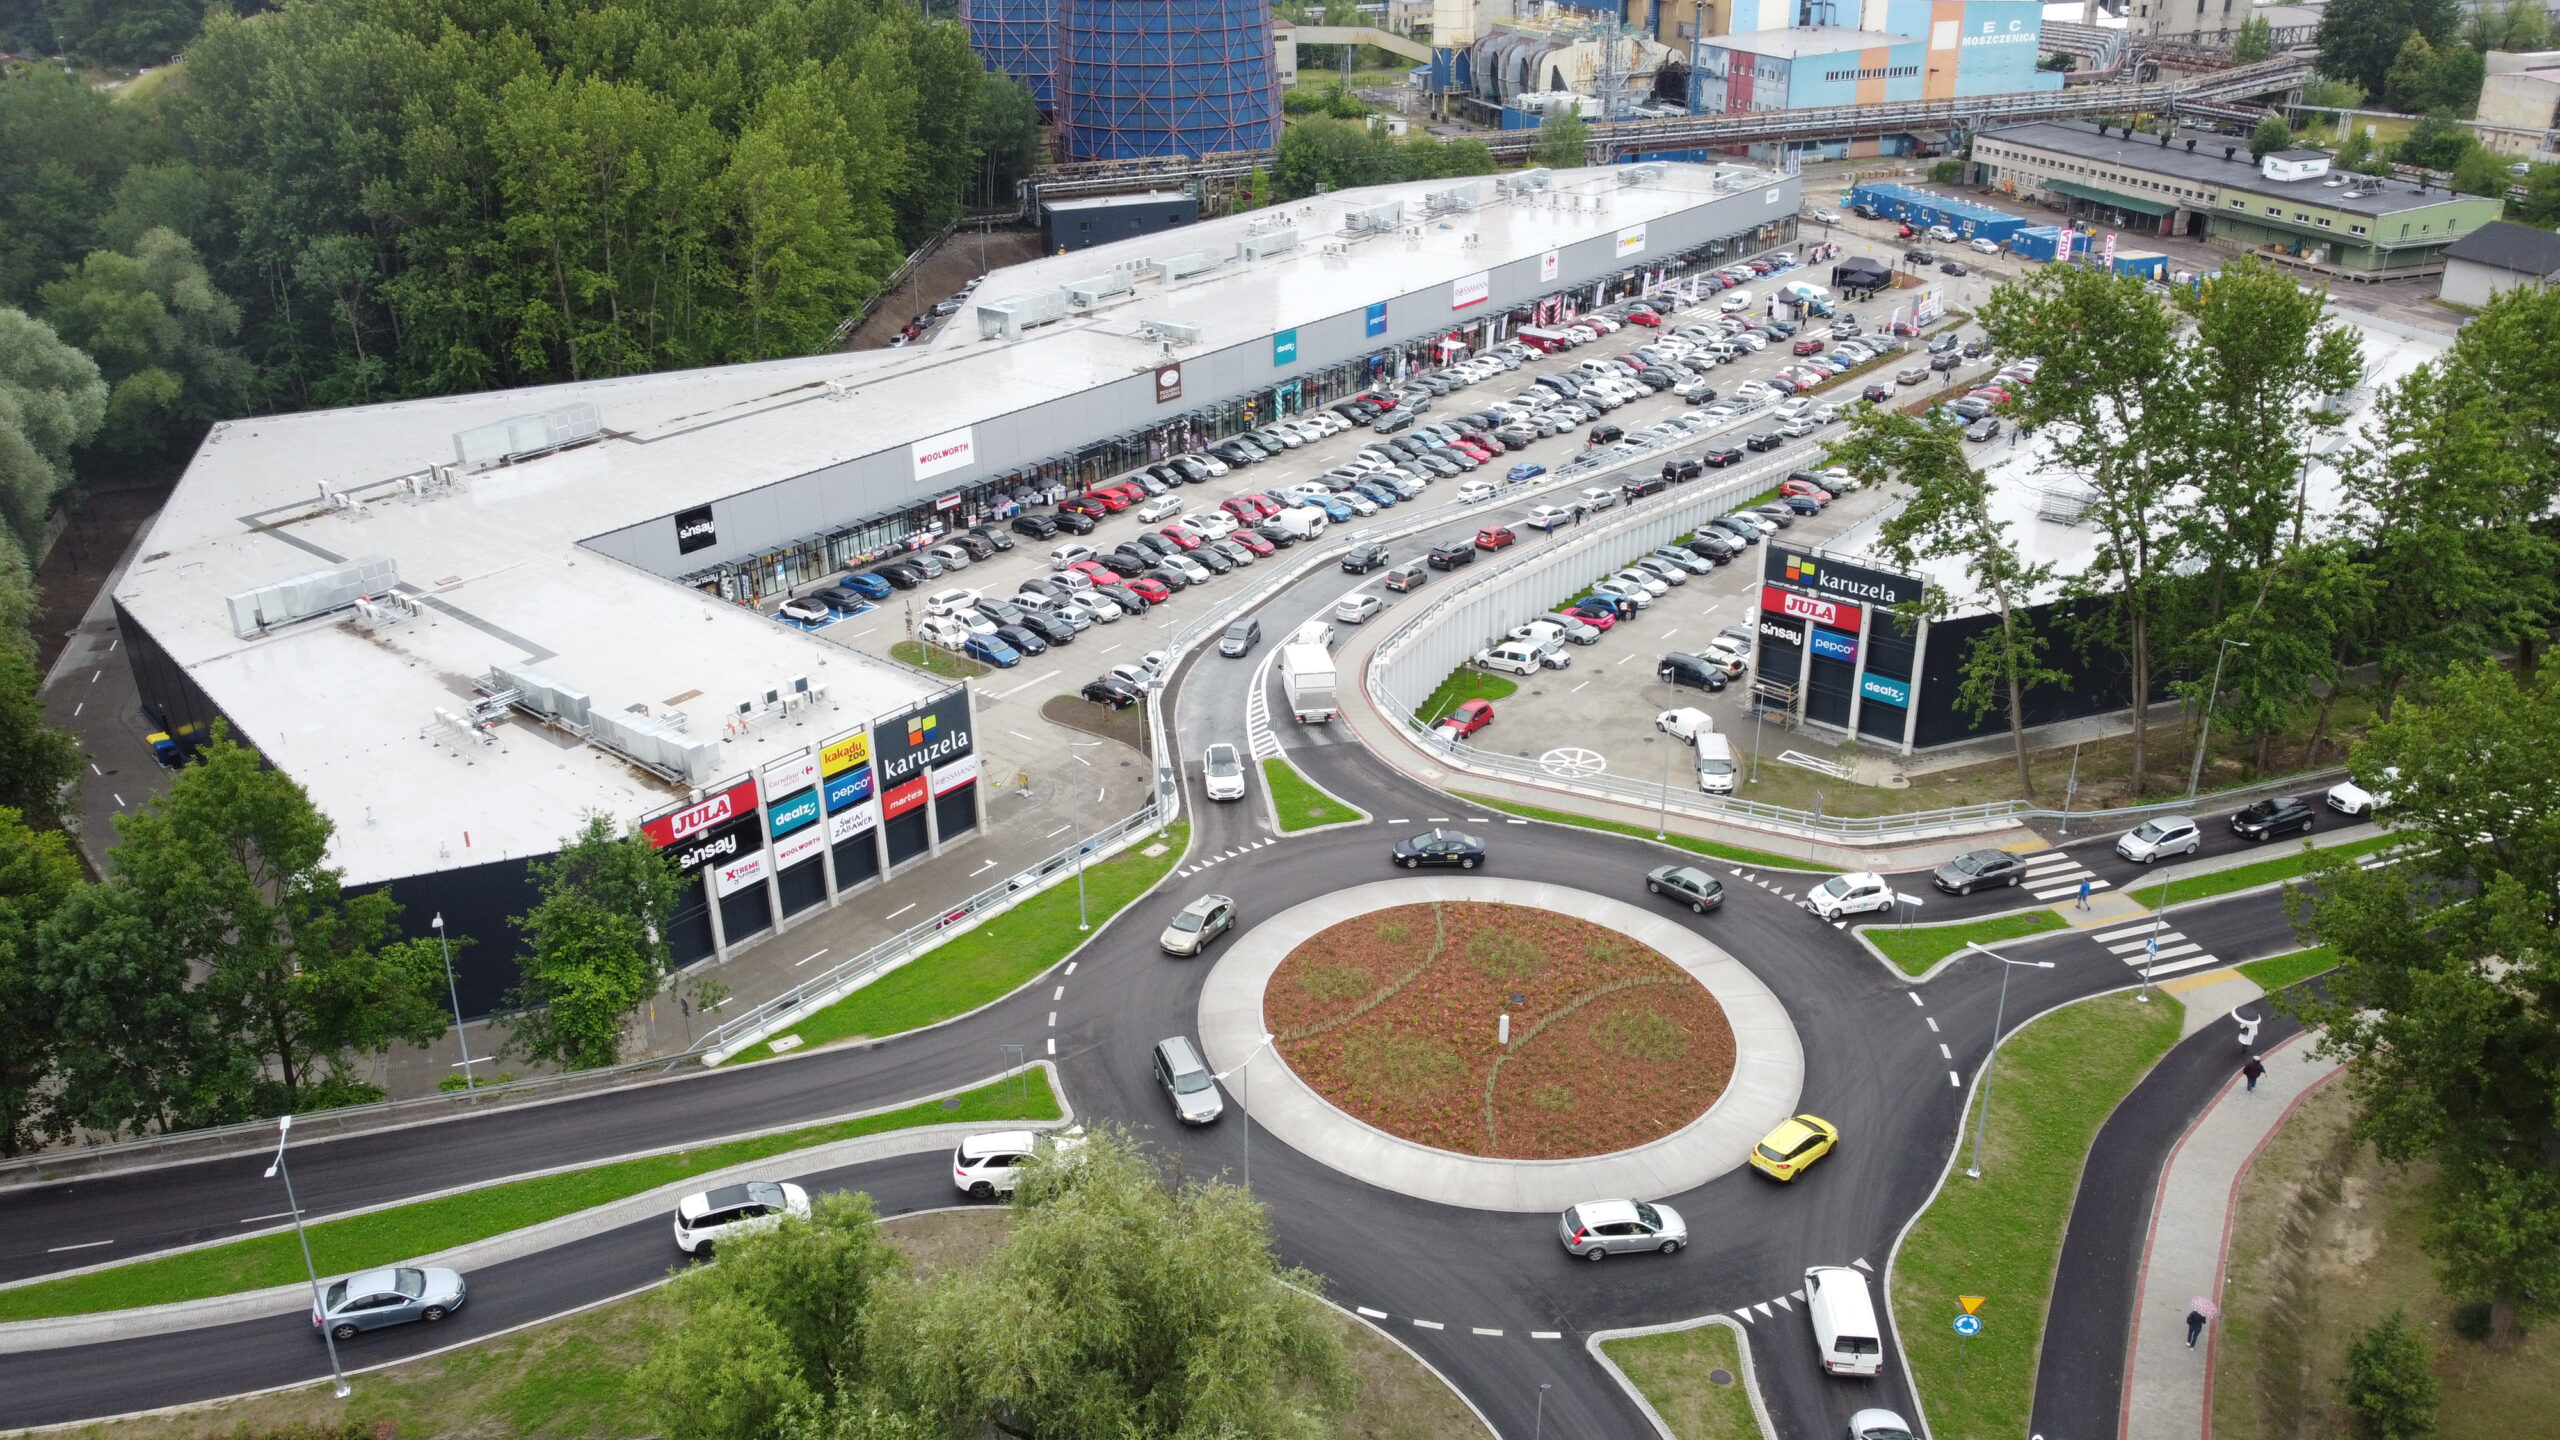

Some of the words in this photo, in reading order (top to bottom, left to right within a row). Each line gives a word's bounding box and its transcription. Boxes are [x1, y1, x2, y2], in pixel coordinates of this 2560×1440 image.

[1962, 33, 2036, 46] MOSZCZENICA
[2058, 231, 2071, 260] JULA
[1454, 280, 1489, 297] ROSSMANN
[919, 443, 969, 464] WOOLWORTH
[680, 520, 715, 539] sinsay
[1819, 569, 1896, 603] karuzela
[1786, 599, 1834, 620] JULA
[1760, 622, 1802, 645] sinsay
[1815, 638, 1851, 655] pepco
[1864, 681, 1904, 702] dealz
[824, 742, 862, 764] kakadu
[848, 749, 866, 762] zoo
[884, 729, 969, 780] karuzela
[768, 771, 799, 789] Carrefour
[935, 765, 976, 787] ROSSMANN
[832, 778, 868, 802] pepco
[890, 789, 924, 810] martes
[674, 797, 730, 837] JULA
[775, 803, 816, 826] dealz
[835, 816, 873, 838] ZABAWEK
[680, 834, 737, 870] sinsay
[779, 836, 821, 859] WOOLWORTH
[726, 860, 760, 882] XTREME
